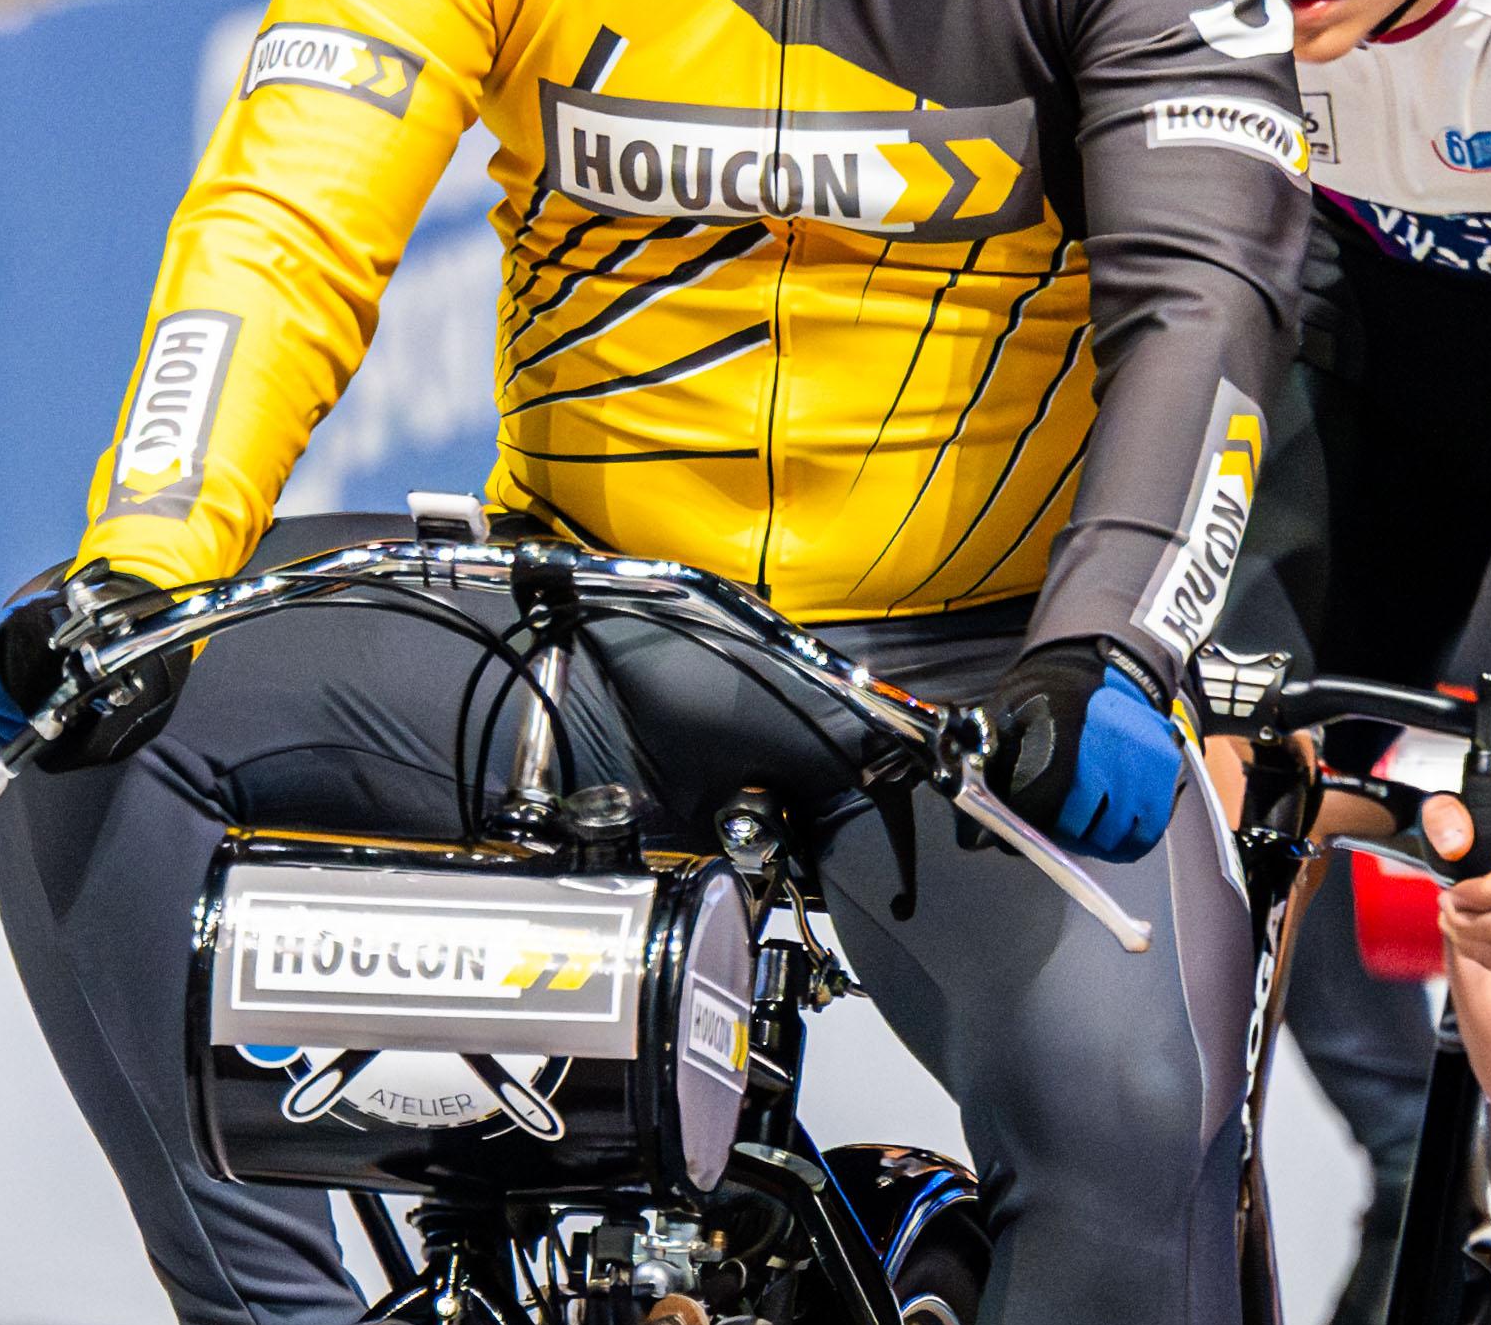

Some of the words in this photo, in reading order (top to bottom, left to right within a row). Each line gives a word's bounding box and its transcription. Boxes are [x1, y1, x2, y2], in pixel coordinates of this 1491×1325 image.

[1166, 104, 1294, 157] HOUCON
[572, 126, 862, 219] HOUCON
[1163, 490, 1246, 640] HOUCON
[272, 931, 488, 981] HOUCON
[369, 1086, 478, 1119] ATELIER
